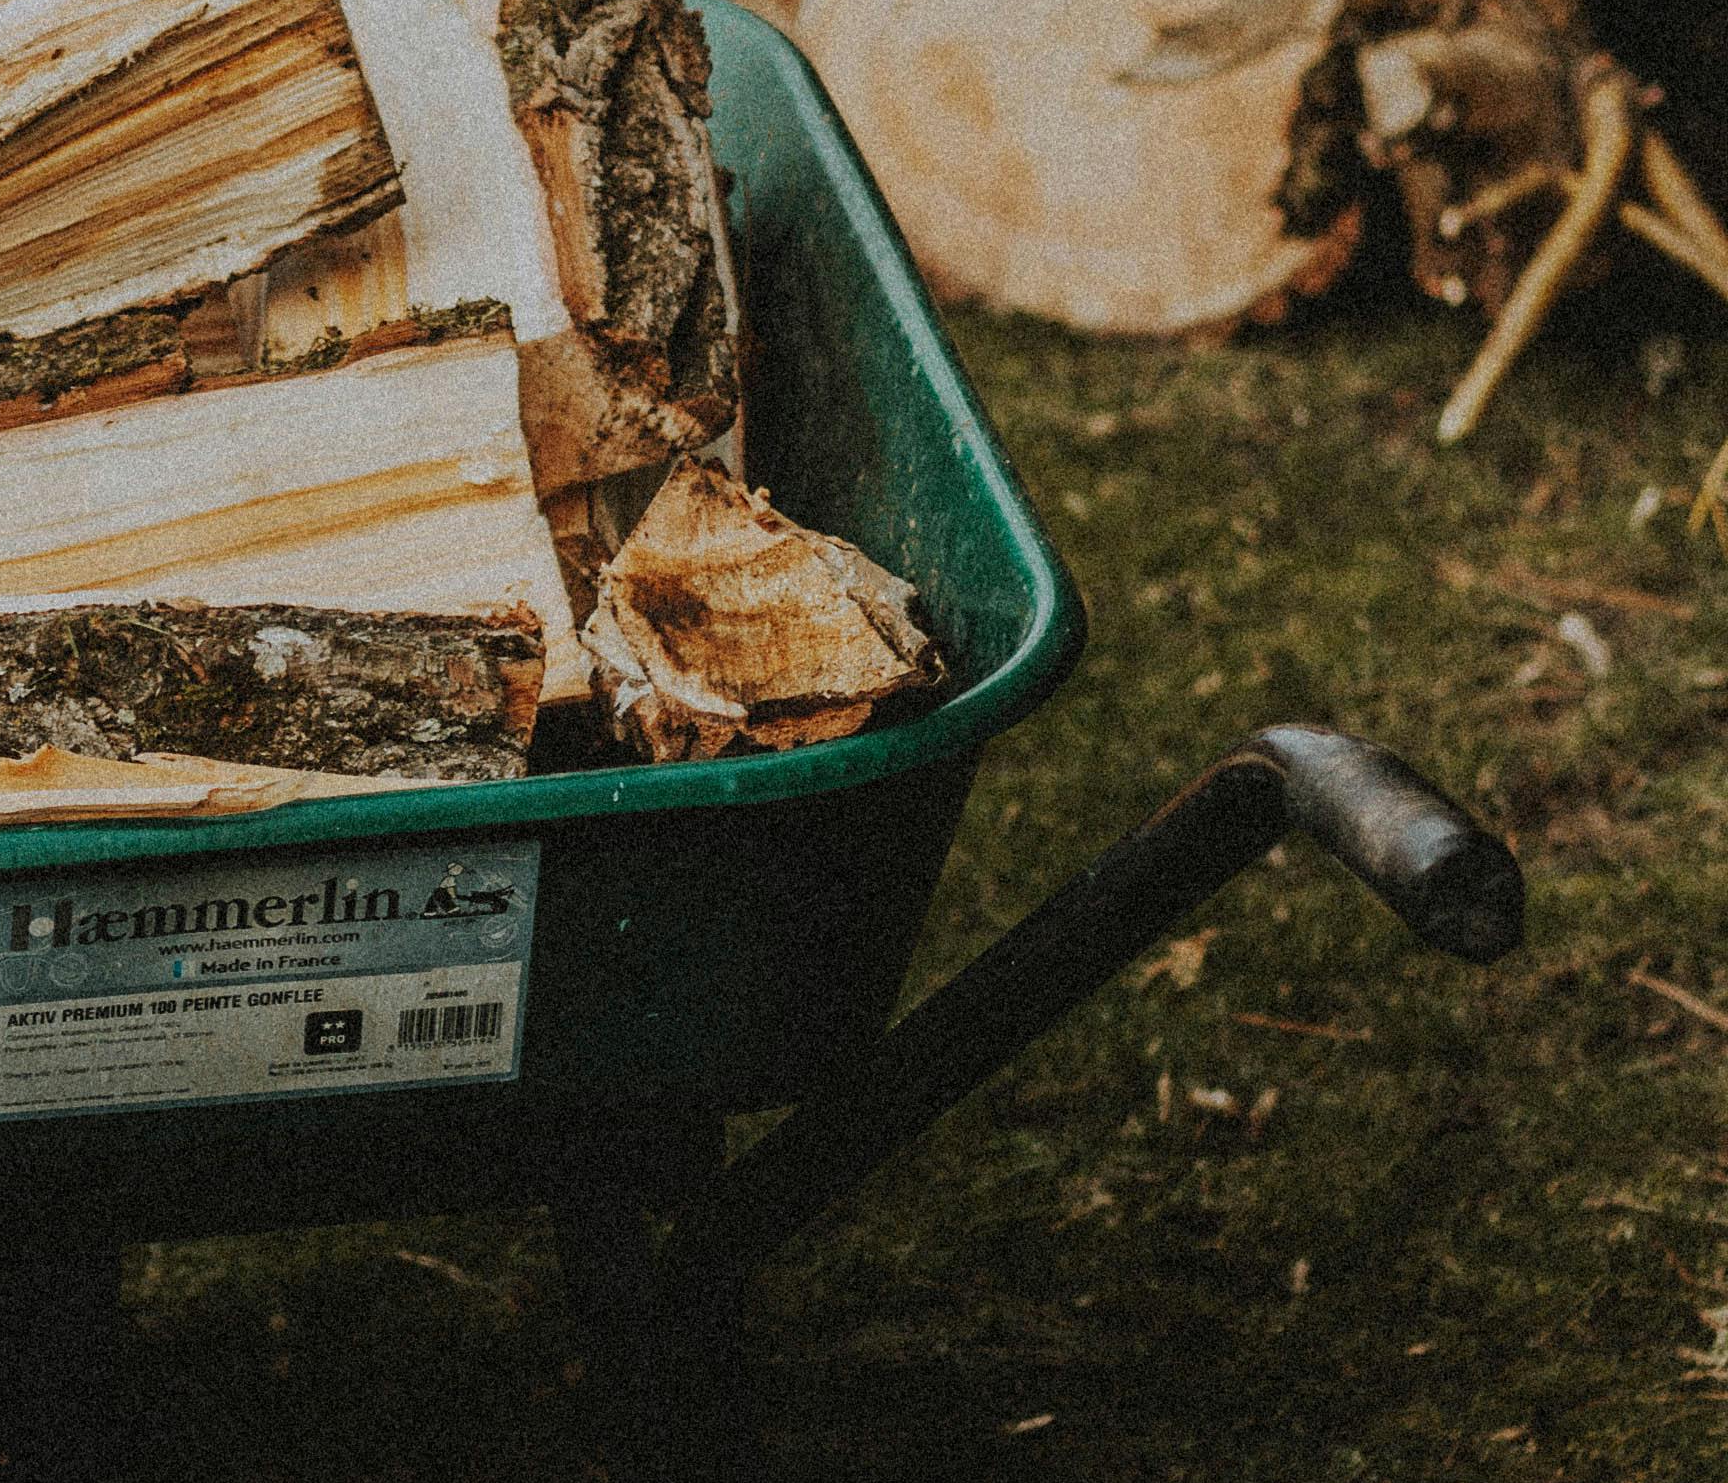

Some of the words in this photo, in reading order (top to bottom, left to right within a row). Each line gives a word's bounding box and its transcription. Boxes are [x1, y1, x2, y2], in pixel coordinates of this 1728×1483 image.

[158, 929, 360, 956] www.haemmerlin.com
[200, 956, 251, 975] Made
[256, 955, 273, 971] in
[278, 953, 341, 970] France
[7, 1009, 57, 1027] AKTIV
[62, 1002, 143, 1023] PREMIUM
[149, 1000, 177, 1016] 100
[182, 994, 242, 1013] PEINTE
[247, 988, 324, 1007] GONFLEE
[320, 1033, 346, 1046] PRO
